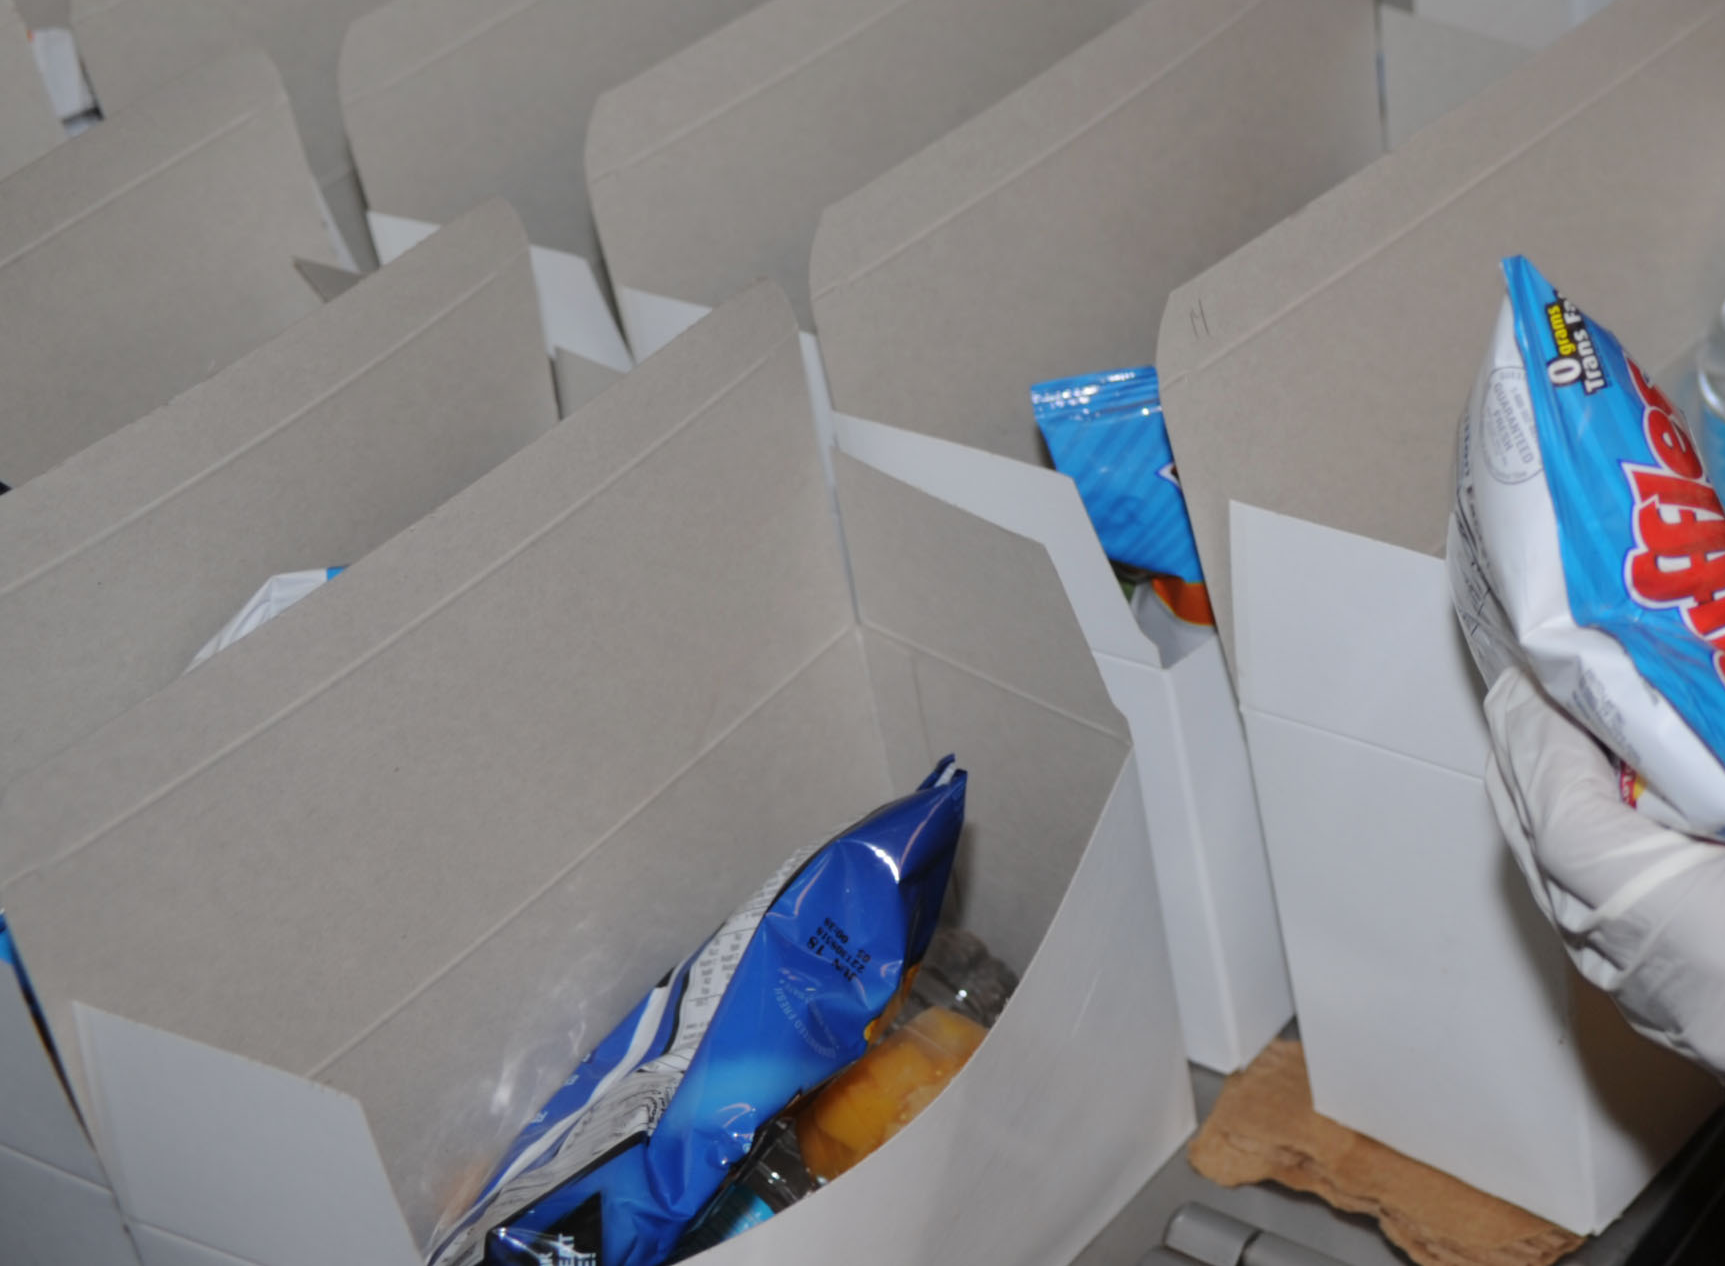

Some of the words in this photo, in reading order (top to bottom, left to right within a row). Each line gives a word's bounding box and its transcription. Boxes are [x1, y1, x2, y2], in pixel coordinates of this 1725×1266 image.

[1547, 304, 1577, 357] grams
[1547, 356, 1583, 385] 0
[1573, 328, 1606, 394] Trans
[1492, 409, 1515, 452] FRESH
[1493, 381, 1535, 465] GUARANTEED
